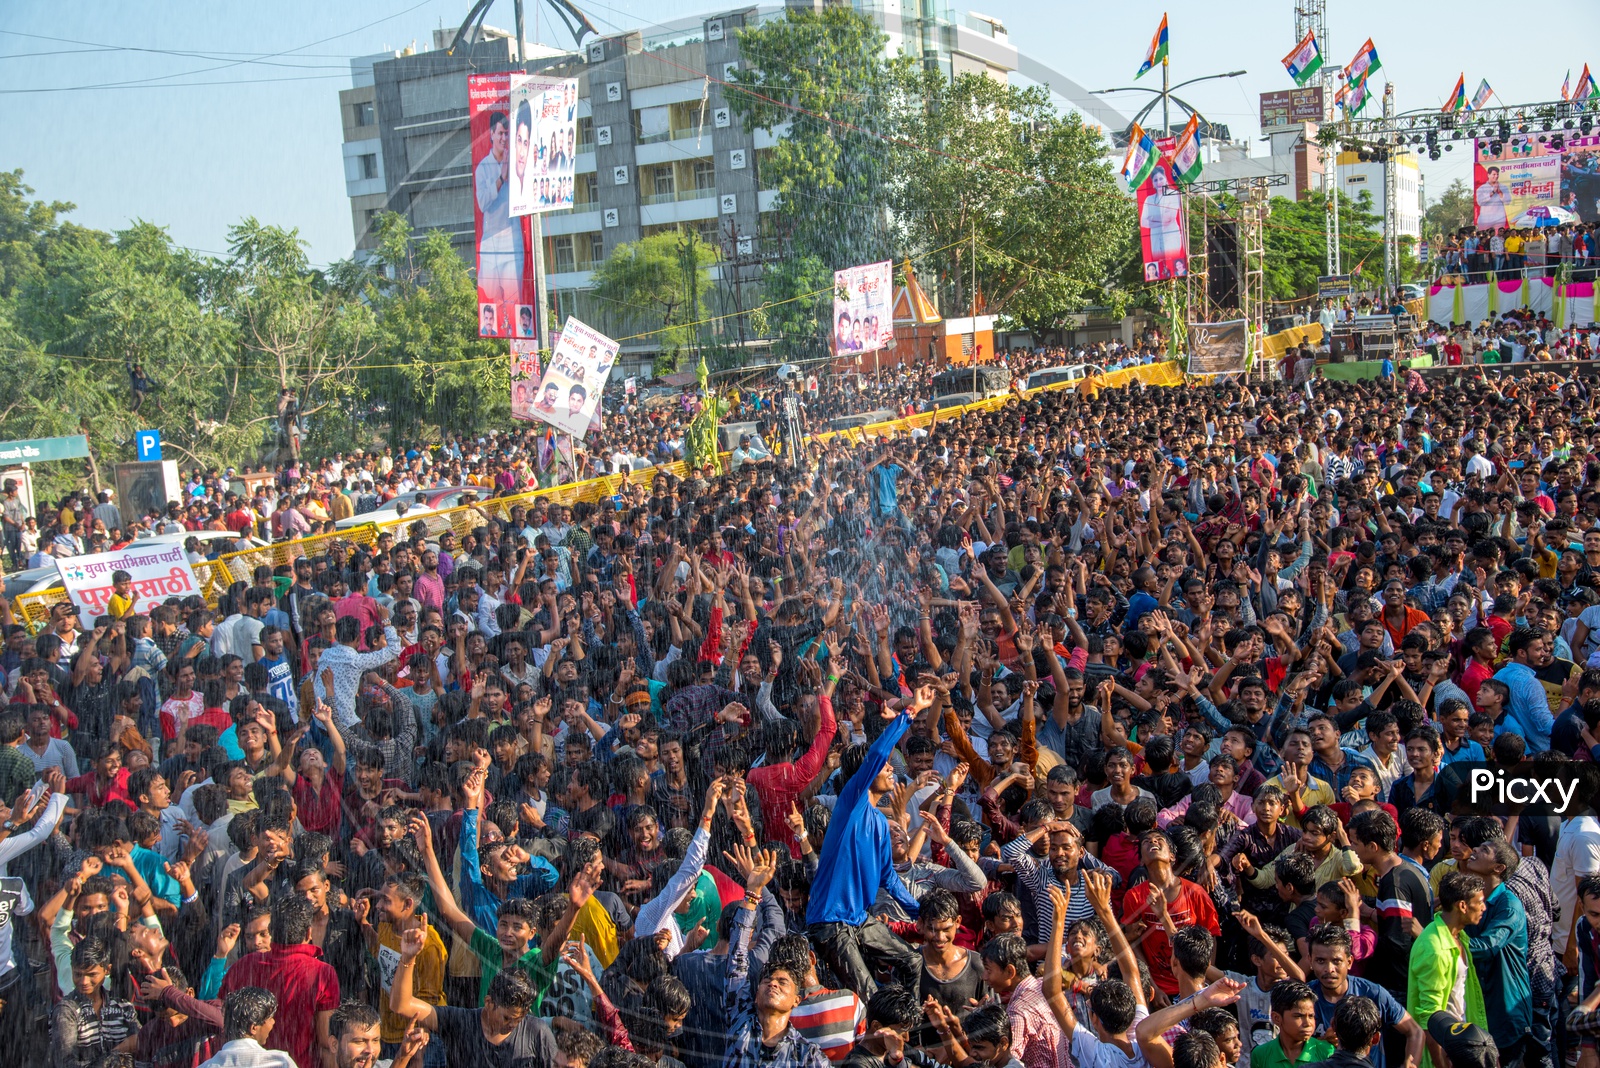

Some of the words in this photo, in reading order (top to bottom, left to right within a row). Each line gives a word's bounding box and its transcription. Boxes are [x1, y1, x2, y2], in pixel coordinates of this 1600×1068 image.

[1501, 165, 1512, 173] युवा
[1513, 161, 1542, 170] स्वाभिमान
[1543, 159, 1557, 167] पार्टी
[574, 325, 584, 334] युवा
[22, 445, 40, 458] चौक
[142, 435, 156, 457] P
[83, 562, 108, 578] युवा
[107, 552, 160, 571] स्वाभिमान
[160, 546, 184, 564] पार्टी
